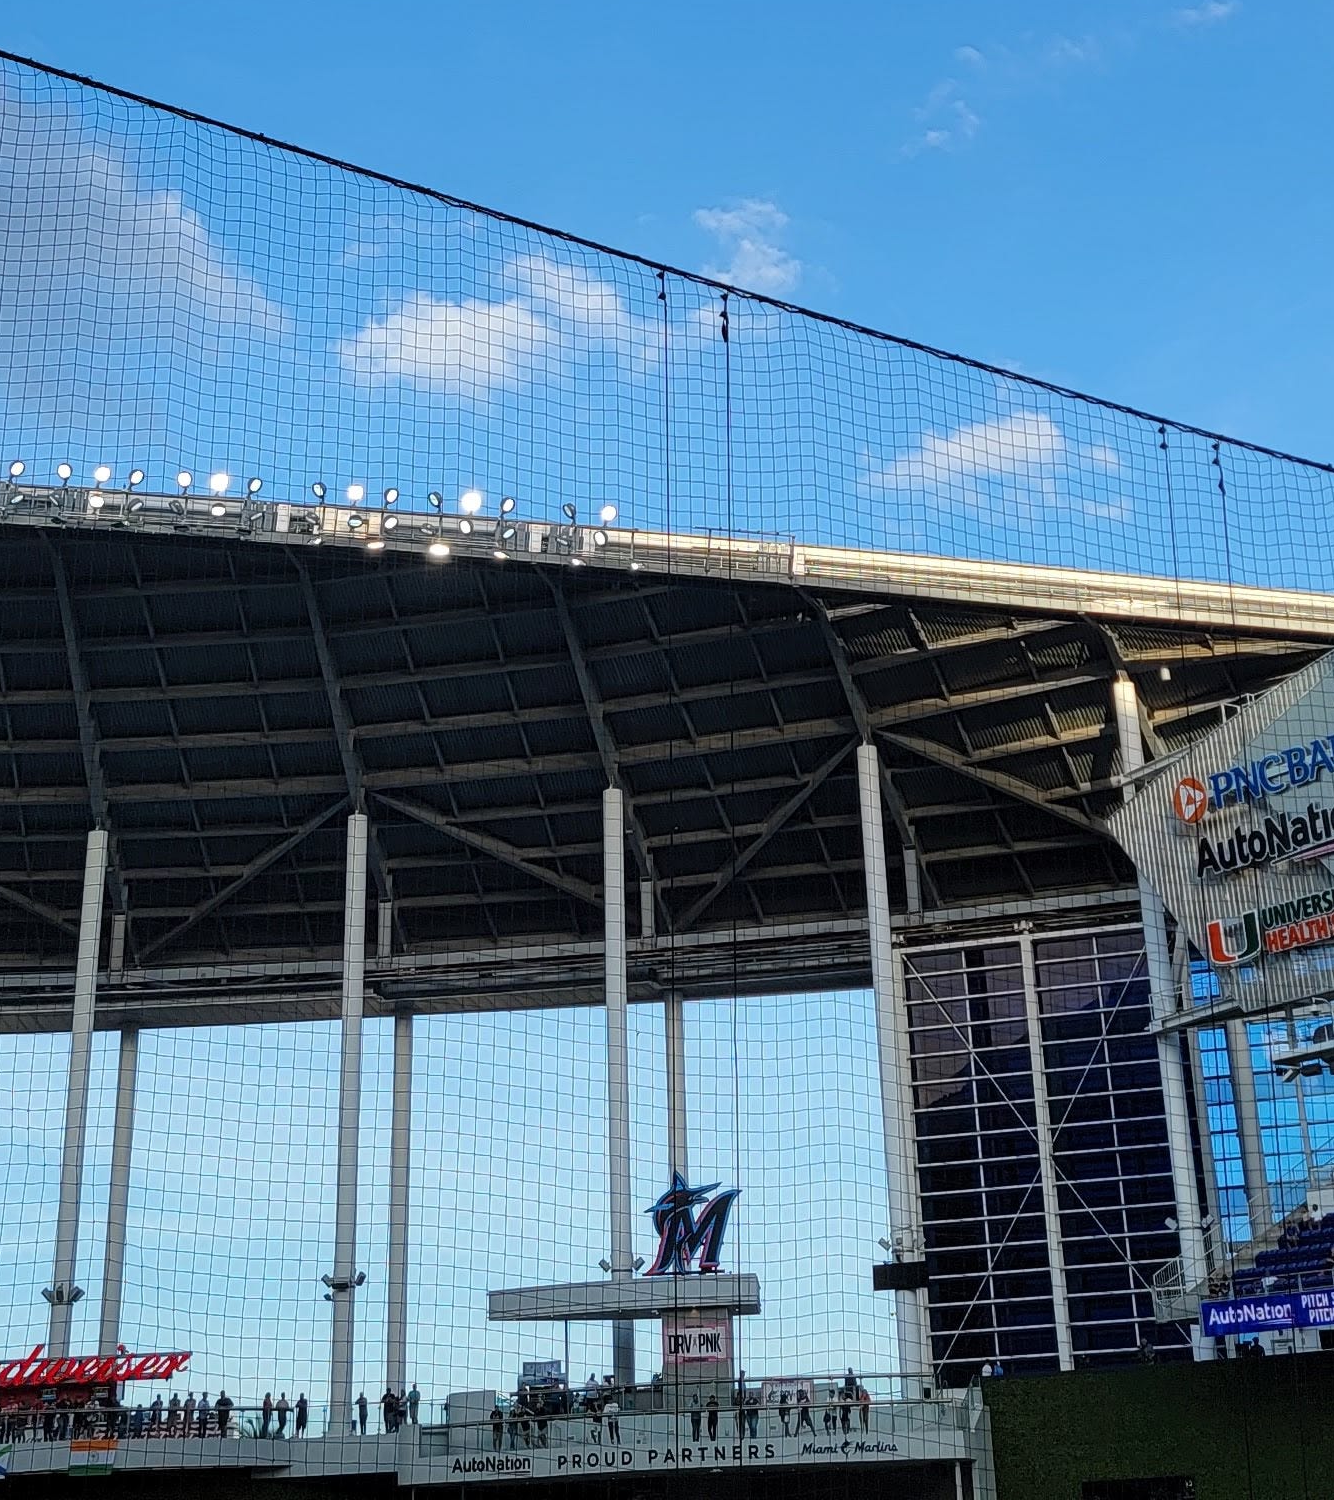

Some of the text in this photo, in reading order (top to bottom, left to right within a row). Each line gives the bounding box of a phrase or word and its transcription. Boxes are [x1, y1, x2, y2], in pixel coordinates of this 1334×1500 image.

[1209, 753, 1286, 809] PNC
[1266, 913, 1331, 954] HEALTH
[1209, 1302, 1292, 1326] AutoNation
[1301, 1293, 1329, 1309] PITCH
[668, 1332, 722, 1354] DRV PNK
[452, 1441, 899, 1473] AutoNation PROUD PARTNERS Miami Marlins
